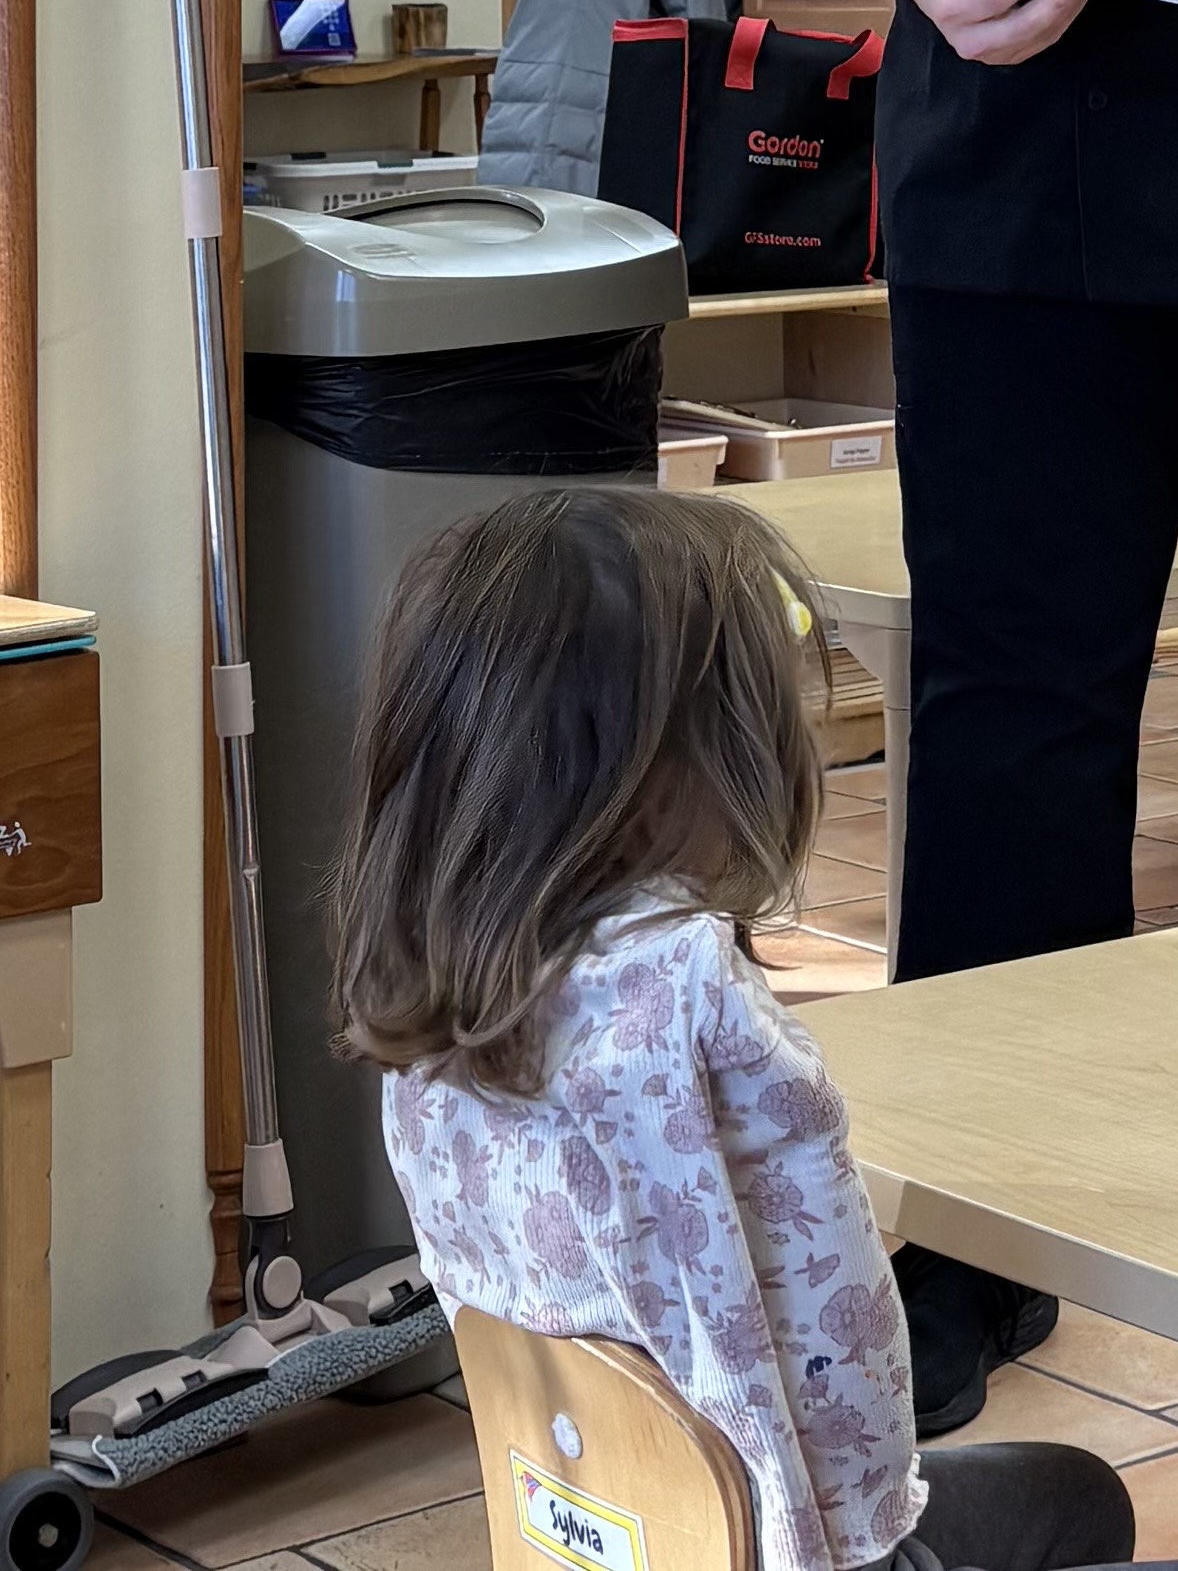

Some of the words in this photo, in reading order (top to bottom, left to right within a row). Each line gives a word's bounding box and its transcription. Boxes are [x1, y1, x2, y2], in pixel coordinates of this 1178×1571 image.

[748, 130, 821, 158] Gordon
[748, 154, 771, 166] FOOD
[549, 1499, 604, 1556] Sylvia
